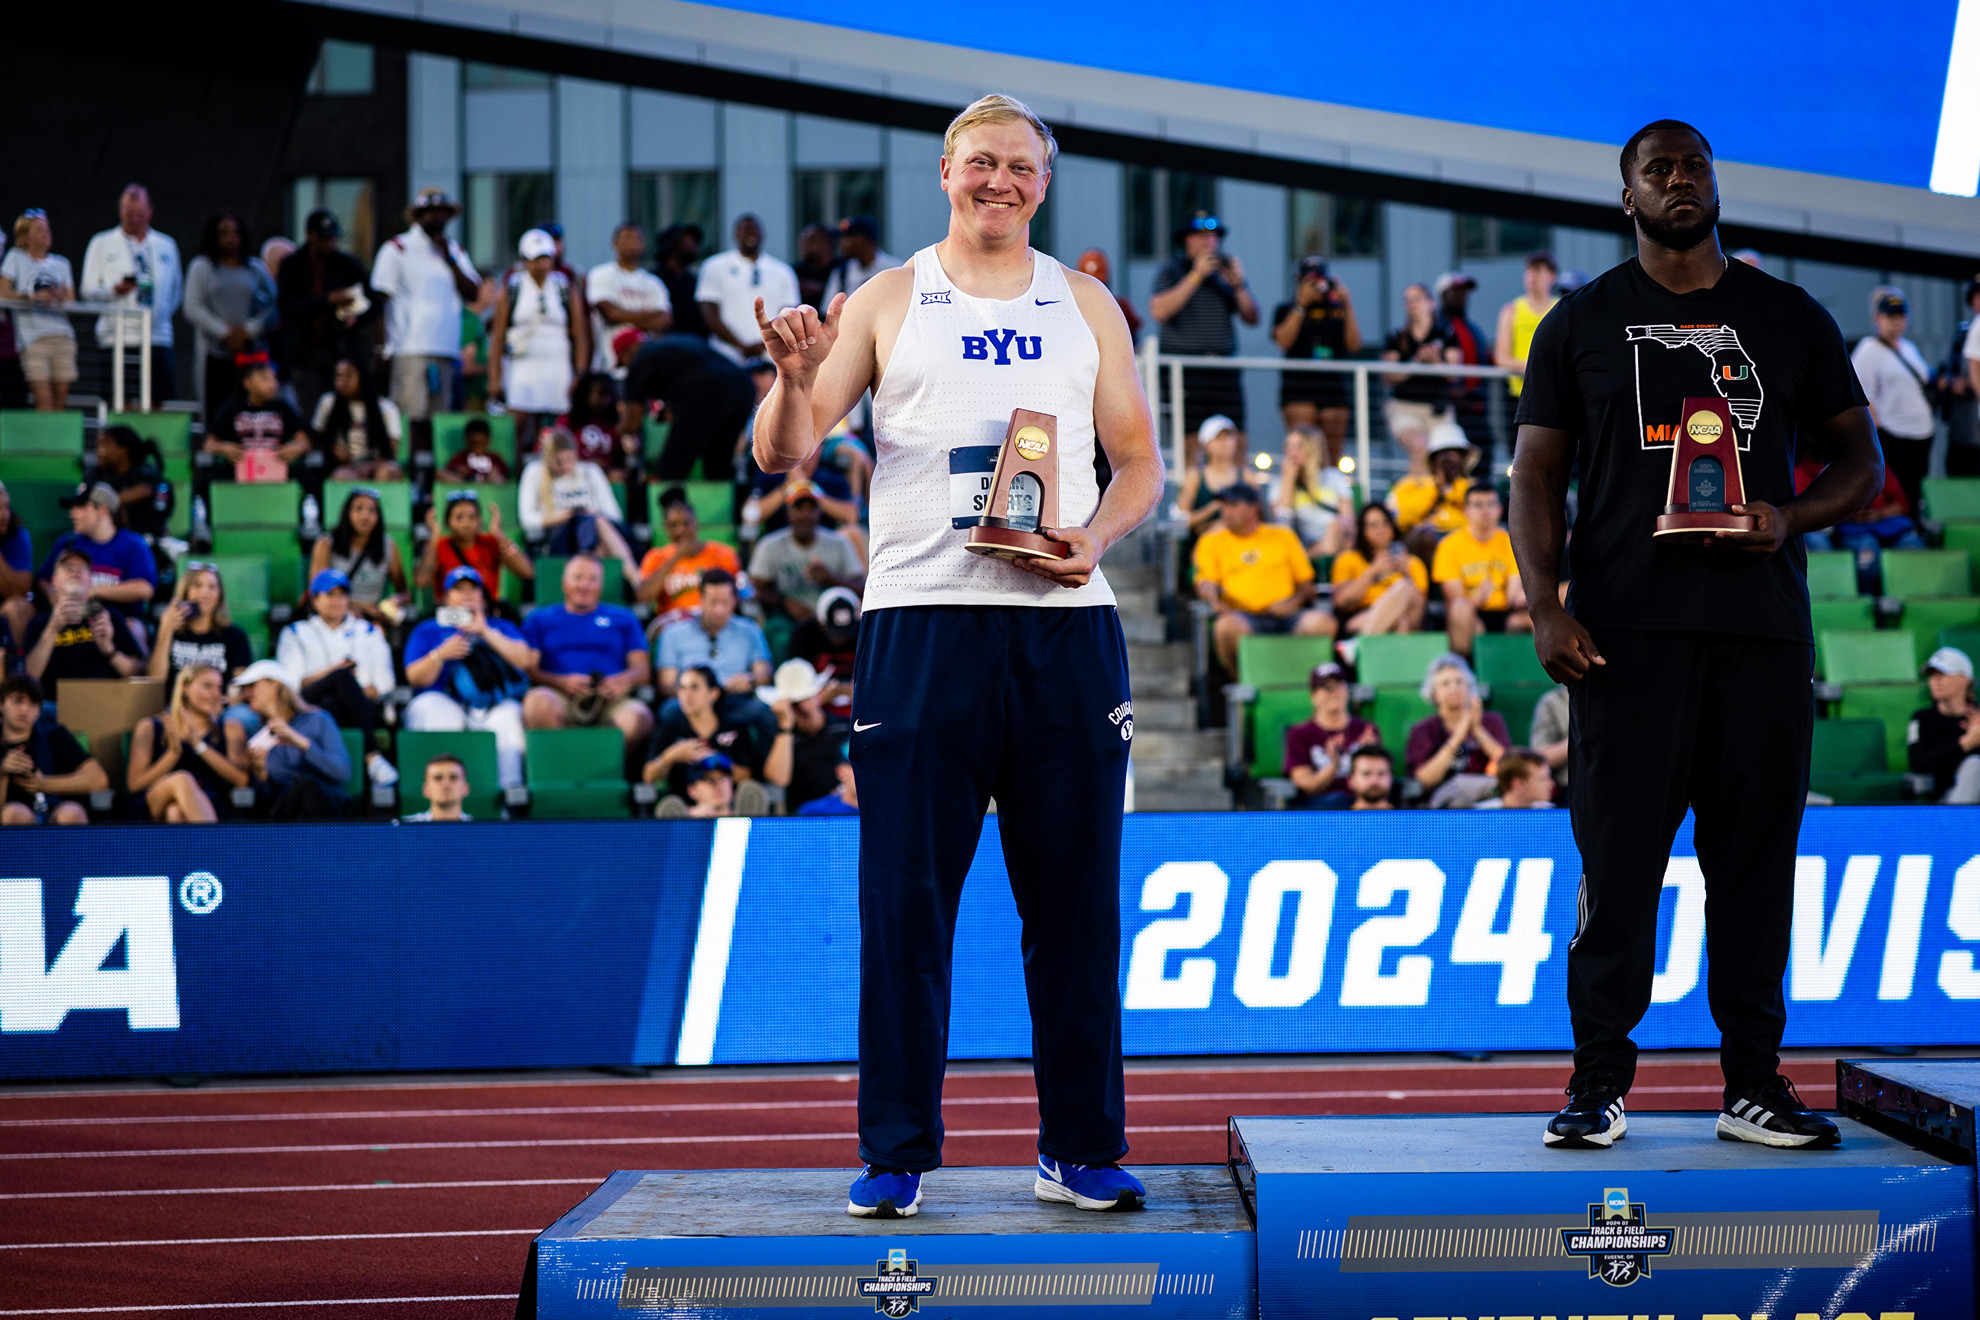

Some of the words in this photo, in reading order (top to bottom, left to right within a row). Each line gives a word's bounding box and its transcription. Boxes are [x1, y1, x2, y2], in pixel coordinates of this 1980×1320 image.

[962, 328, 1042, 365] BYU
[1723, 365, 1748, 380] U
[1690, 425, 1722, 436] NCAA
[1018, 438, 1048, 453] NCAA
[973, 494, 1033, 512] SRTS
[1123, 857, 1554, 1010] 2024
[1590, 1226, 1616, 1235] TRACK
[1616, 1226, 1623, 1235] &
[1624, 1226, 1645, 1235] FIELD
[1571, 1235, 1666, 1249] CHAMPIONSHIPS
[878, 1275, 896, 1283] TRACK
[901, 1275, 917, 1283] FIELD
[863, 1282, 931, 1292] CHAMPIONSHIPS
